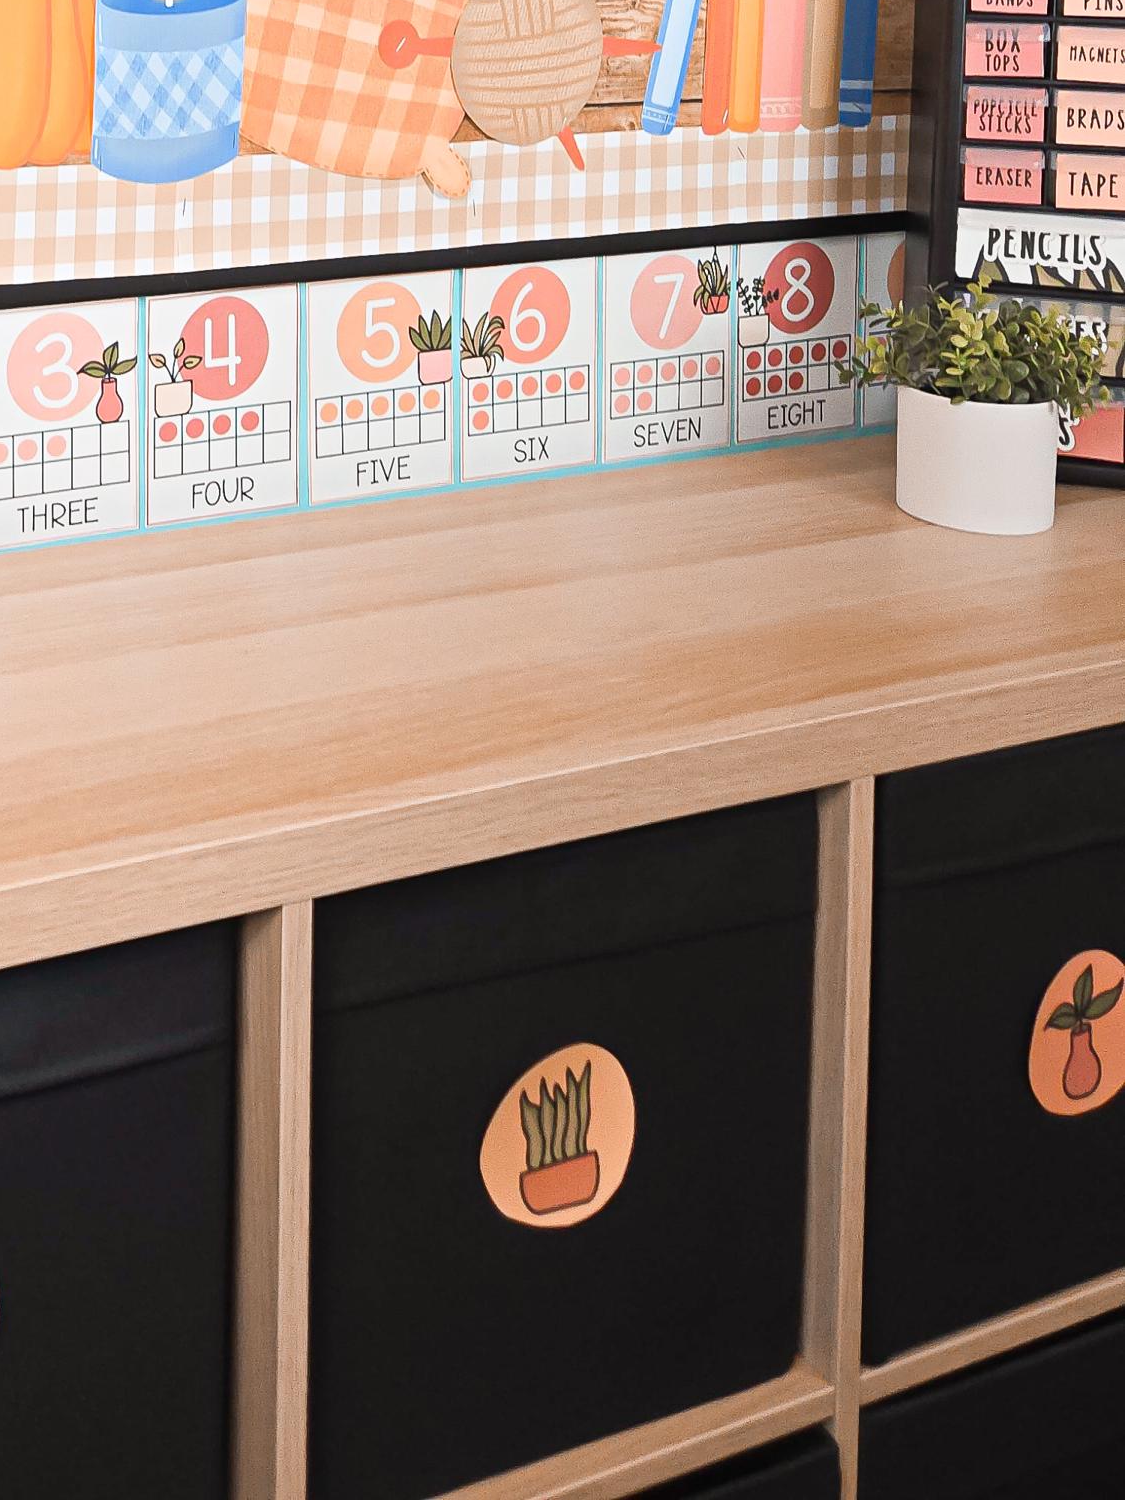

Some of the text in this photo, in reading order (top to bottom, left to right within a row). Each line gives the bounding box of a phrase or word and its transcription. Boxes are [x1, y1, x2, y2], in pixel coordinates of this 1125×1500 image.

[985, 28, 1021, 53] BOX
[986, 54, 1020, 73] TOPS
[979, 113, 1031, 134] STICKS
[1067, 108, 1125, 131] BRADS
[976, 167, 1031, 188] ERASER
[1069, 172, 1118, 198] TAPE
[988, 228, 1101, 266] PENCILS
[653, 272, 685, 340] 7
[780, 257, 815, 322] 8
[361, 297, 403, 368] 5
[510, 282, 547, 353] 6
[203, 313, 241, 386] 4
[33, 332, 79, 408] 3
[767, 399, 826, 430] EIGHT
[514, 435, 550, 463] SIX
[633, 417, 701, 448] SEVEN
[356, 455, 411, 488] FIVE
[192, 476, 255, 510] FOUR
[17, 497, 99, 534] THREE
